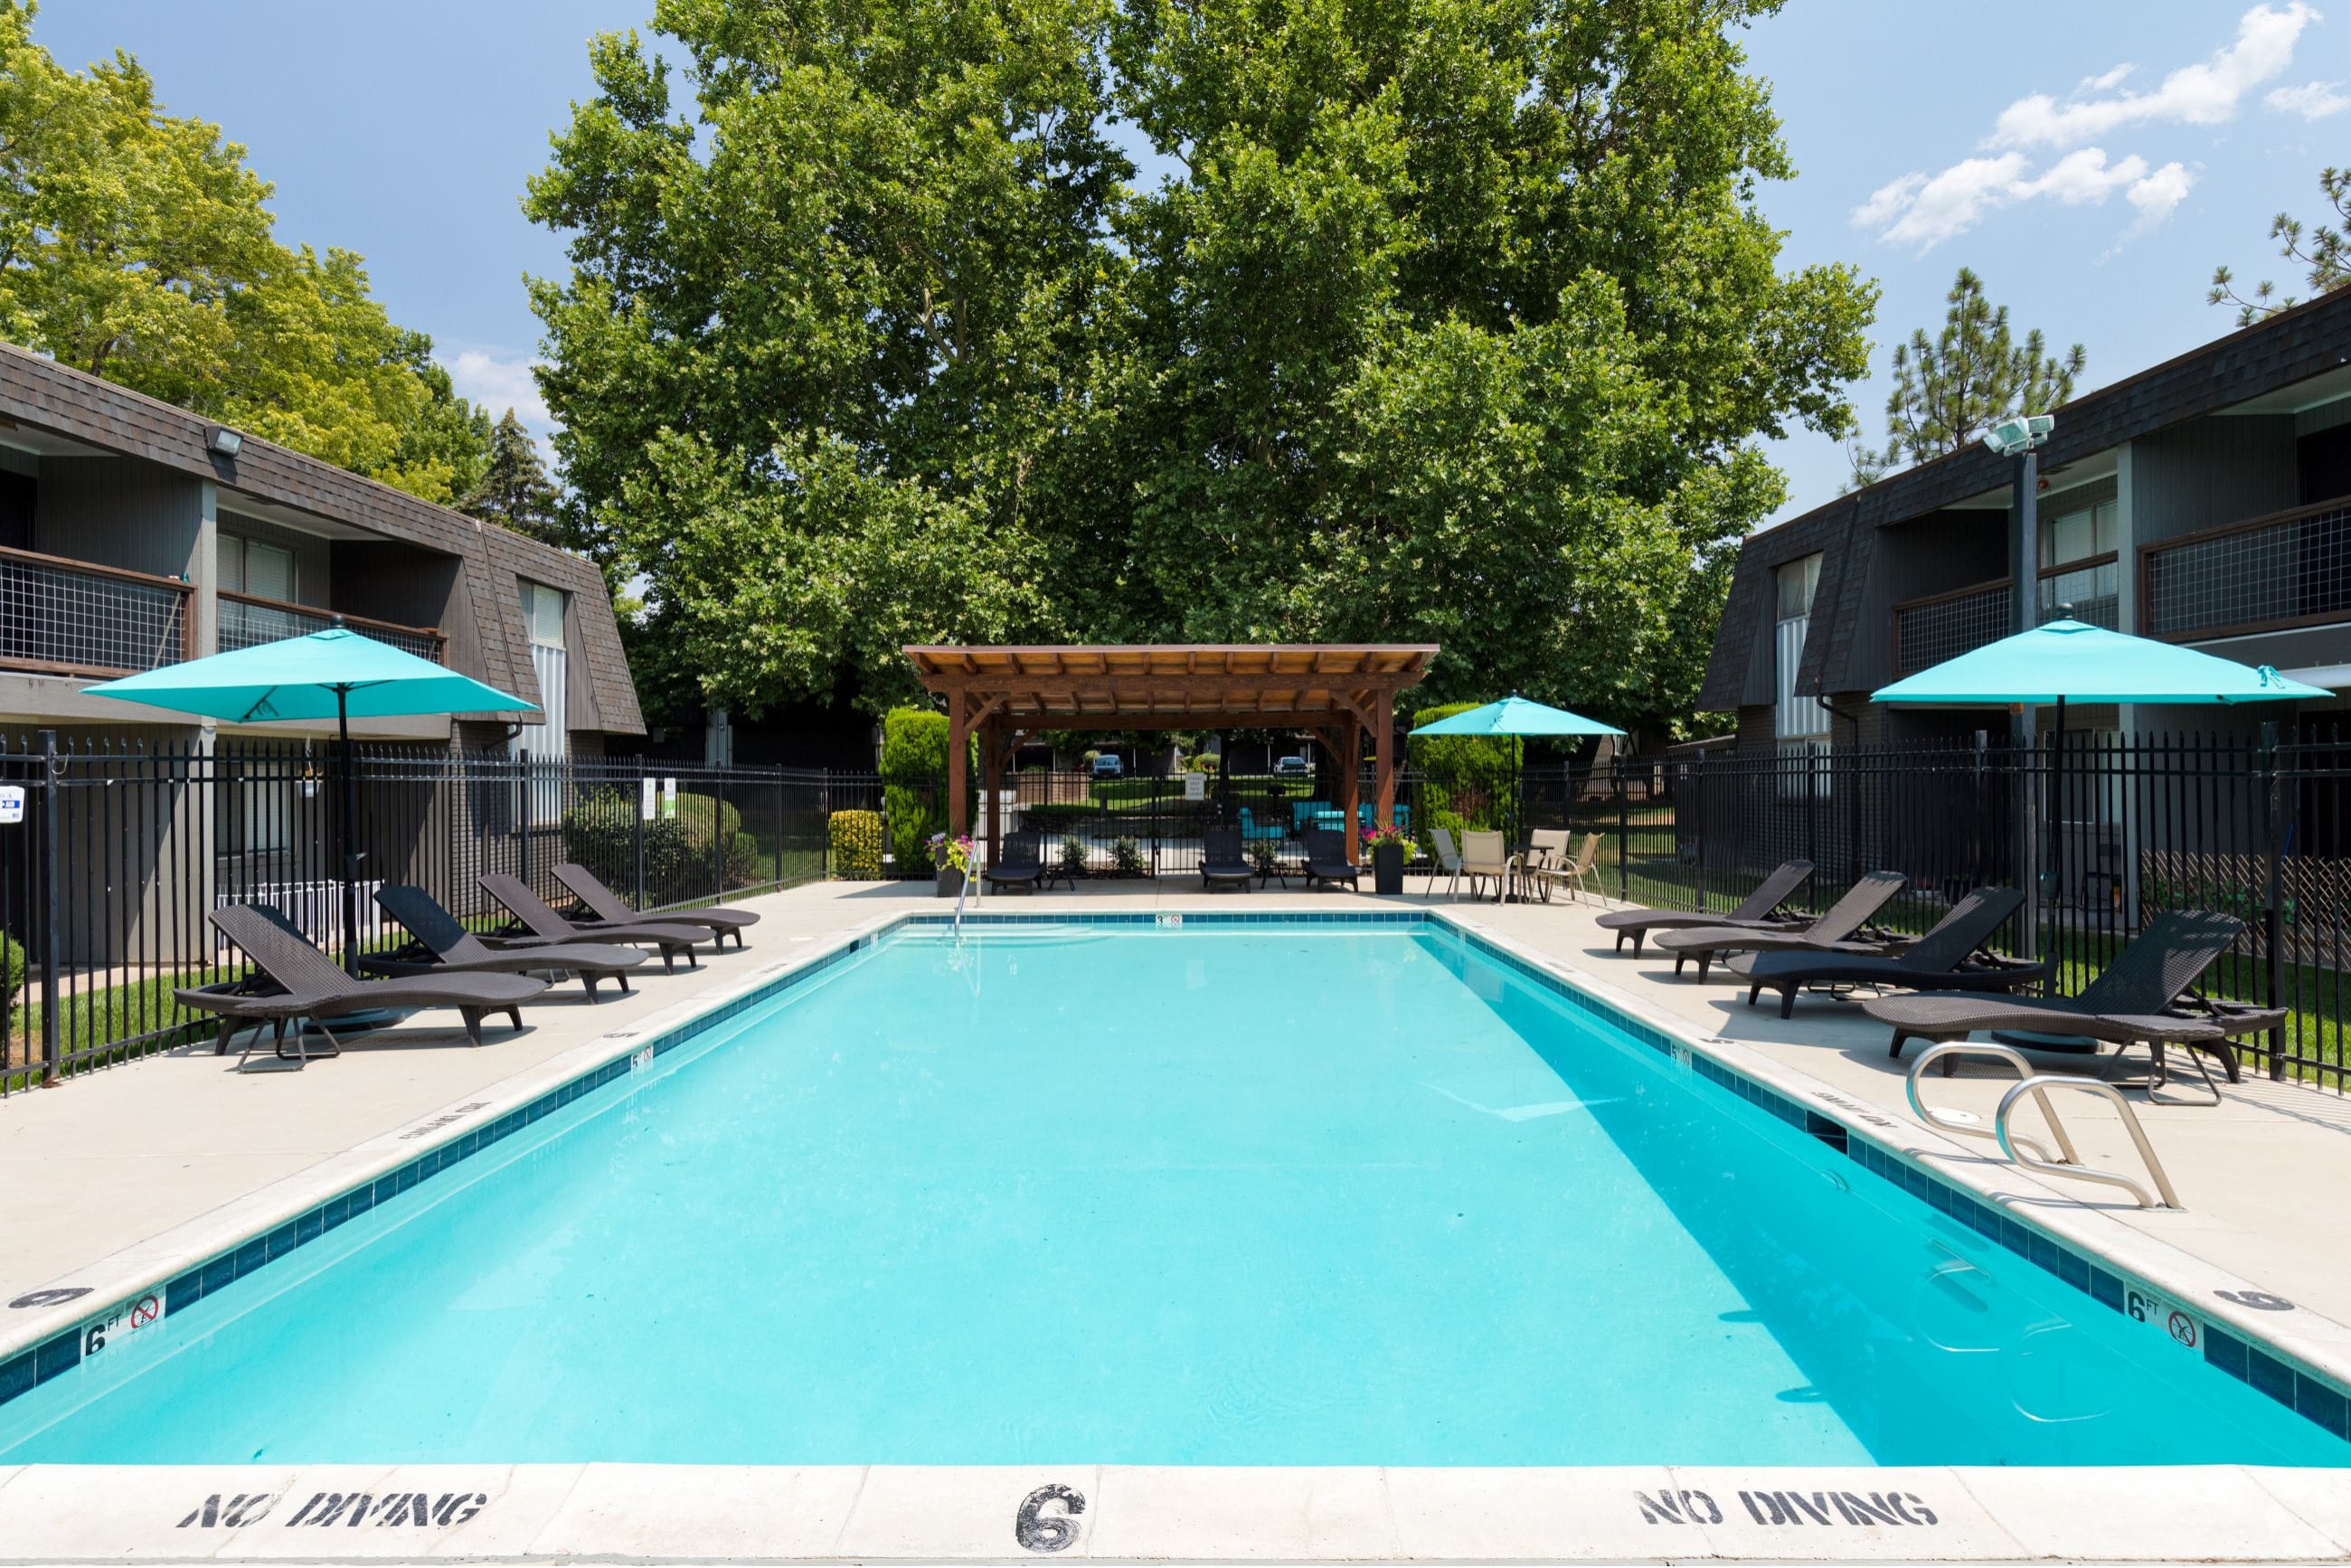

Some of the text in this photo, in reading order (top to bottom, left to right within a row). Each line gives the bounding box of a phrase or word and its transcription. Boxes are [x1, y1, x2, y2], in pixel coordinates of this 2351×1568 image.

[632, 1054, 638, 1068] 5
[8, 1287, 95, 1308] 6
[2128, 1290, 2159, 1323] 6 FT
[2213, 1290, 2296, 1311] 6
[85, 1323, 107, 1356] 6
[107, 1313, 122, 1332] FT
[175, 1492, 487, 1528] NO DIVING
[1015, 1483, 1086, 1554] 6
[1633, 1489, 1940, 1526] NO DIVING
